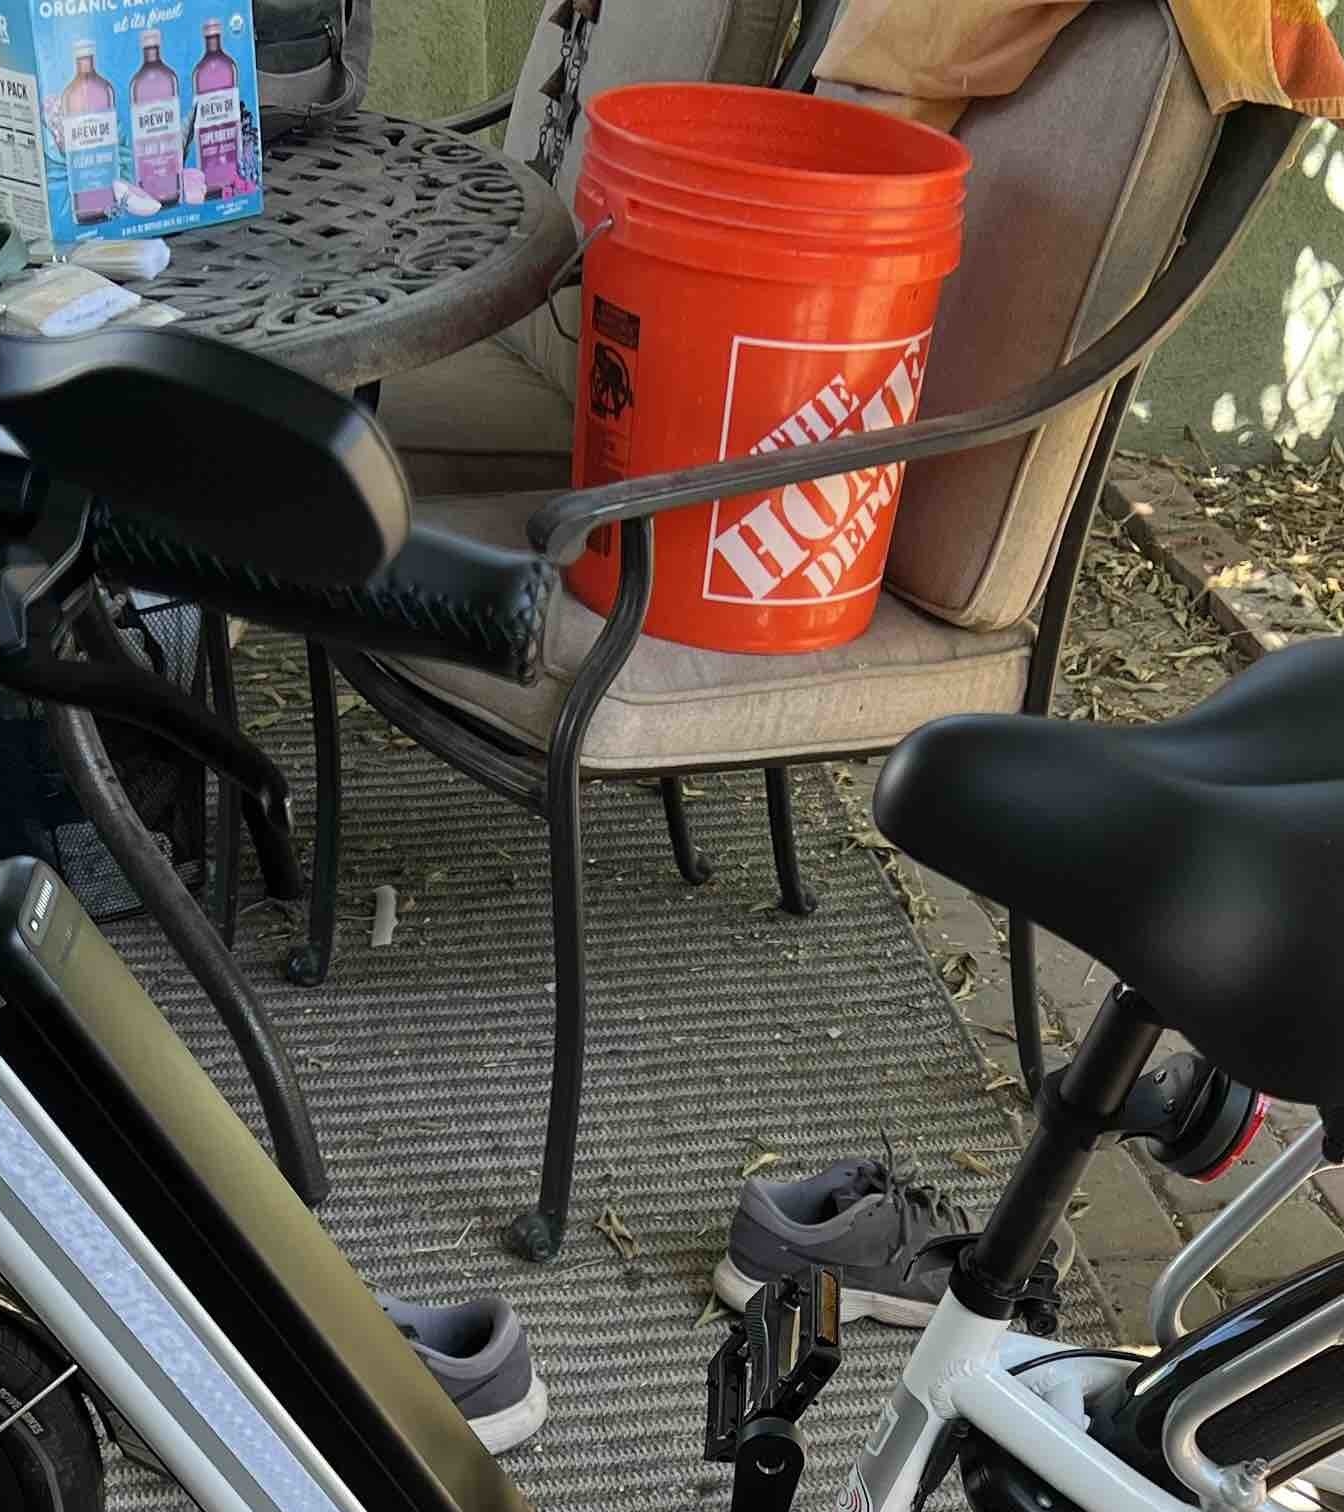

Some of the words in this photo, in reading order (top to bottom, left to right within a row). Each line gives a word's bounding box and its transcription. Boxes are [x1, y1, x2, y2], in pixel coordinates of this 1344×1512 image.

[39, 0, 118, 18] ORGANIC
[7, 80, 29, 101] PACK
[201, 102, 223, 117] BREW
[139, 111, 164, 129] BREW
[71, 124, 98, 138] BREW
